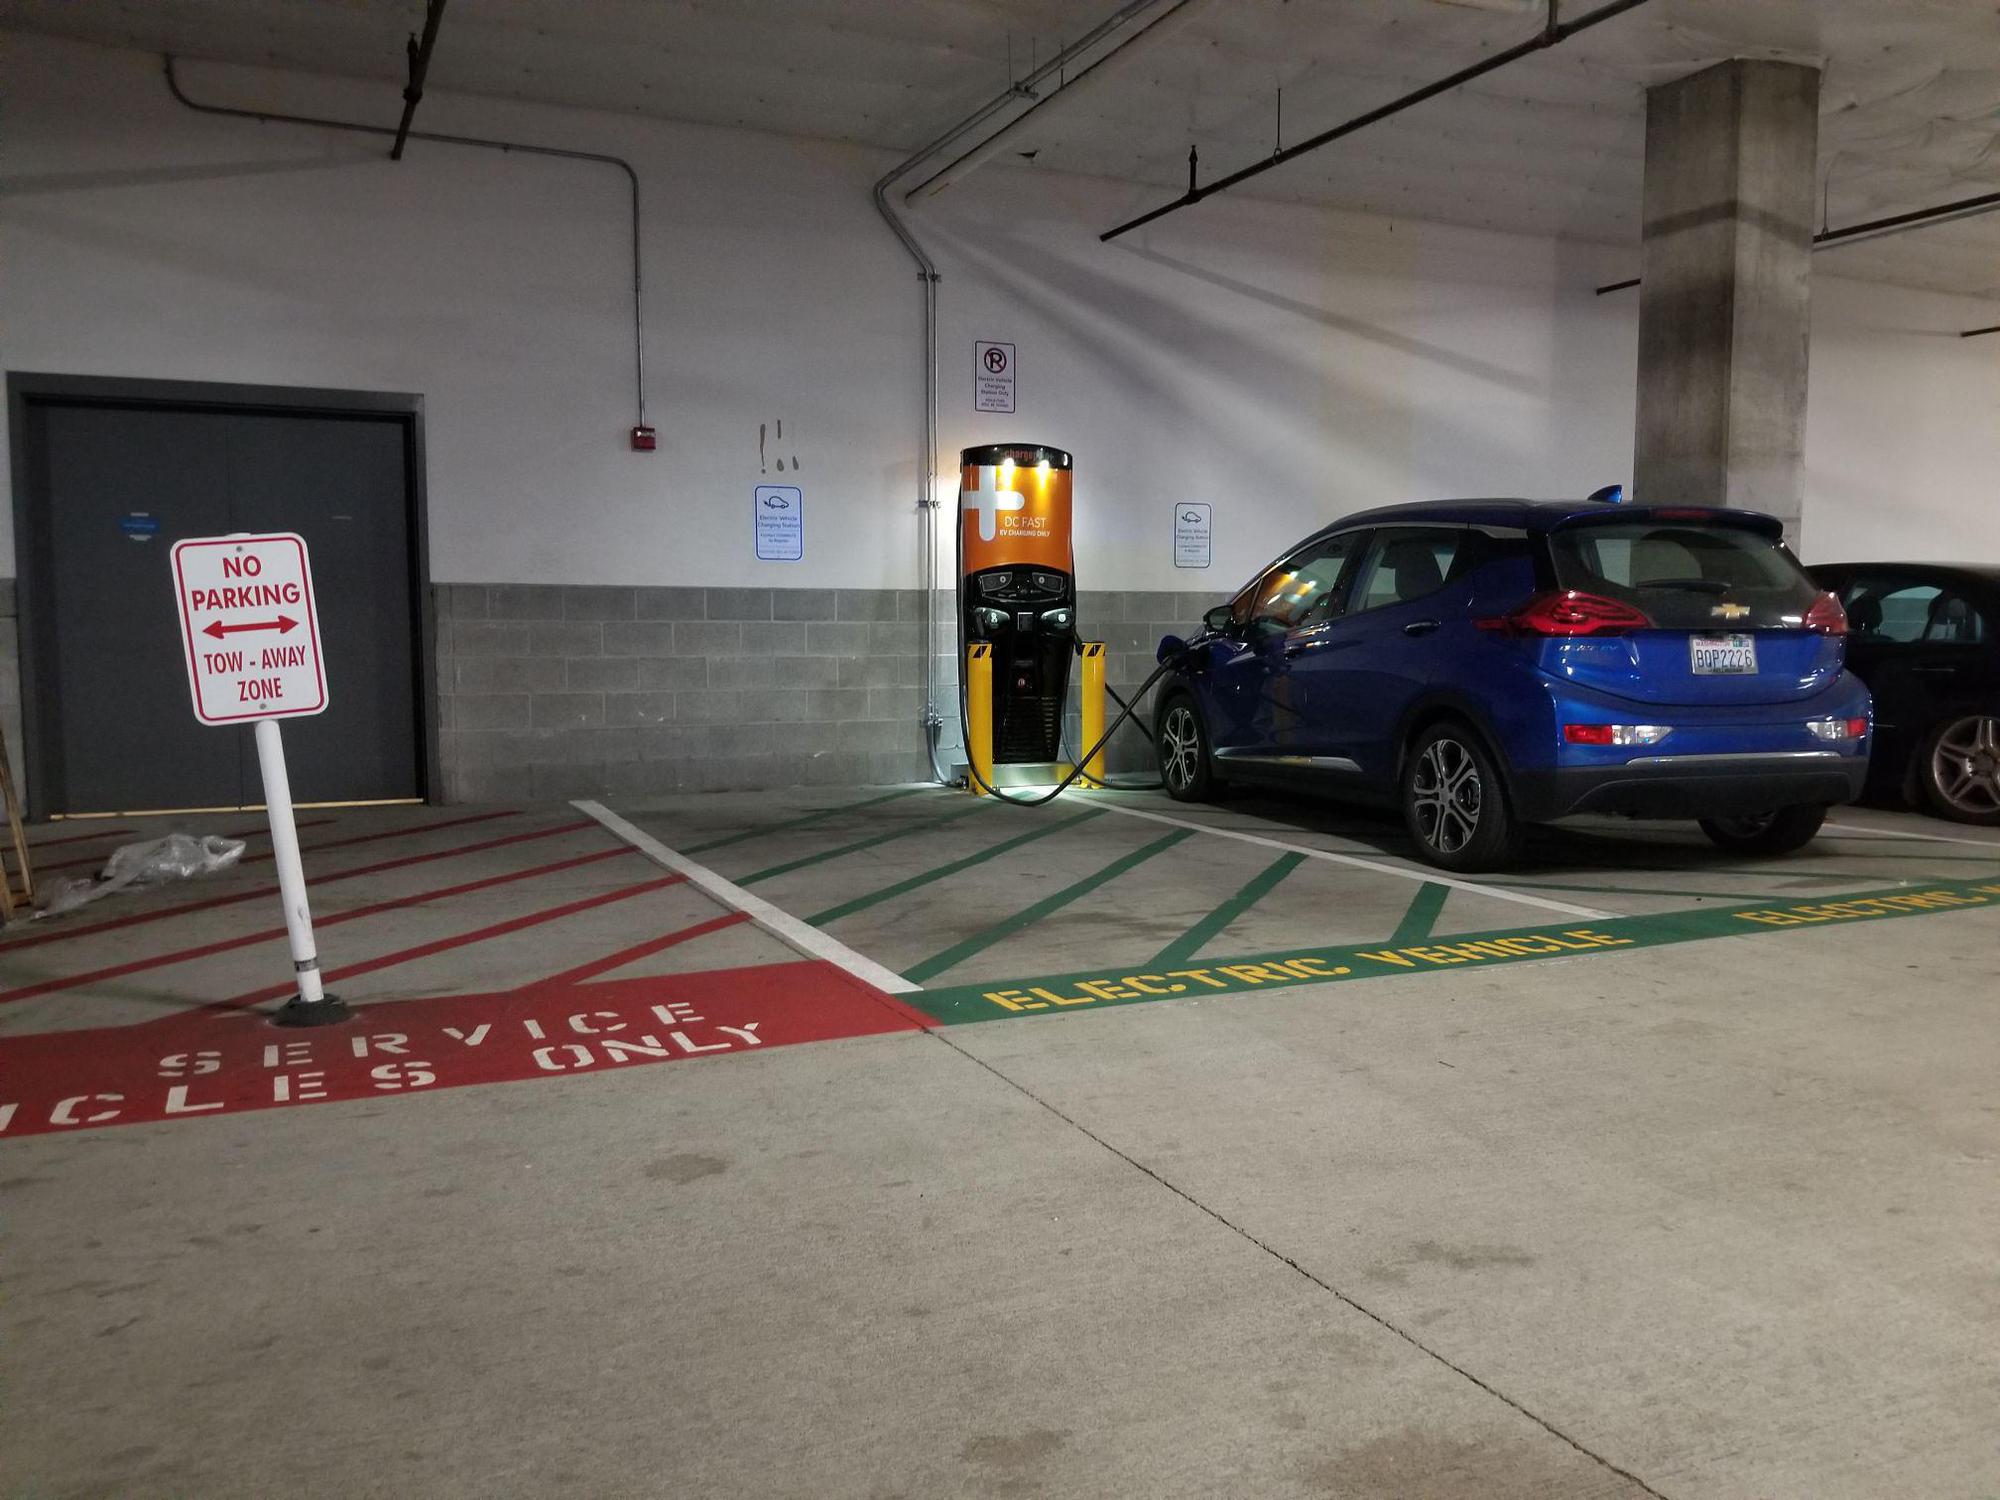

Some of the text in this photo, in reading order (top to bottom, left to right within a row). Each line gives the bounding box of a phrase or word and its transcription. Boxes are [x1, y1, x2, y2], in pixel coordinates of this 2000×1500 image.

[1004, 515, 1048, 529] DC FAST
[222, 555, 262, 578] NO
[191, 583, 300, 611] PARKING
[204, 651, 243, 675] TOW
[262, 645, 306, 670] AWAY
[1696, 648, 1753, 668] BQP2226
[237, 677, 283, 702] ZONE
[983, 930, 1635, 1012] ELECTRIC VEHICLE
[158, 1002, 705, 1077] SERVICE
[531, 1022, 762, 1070] ONLY
